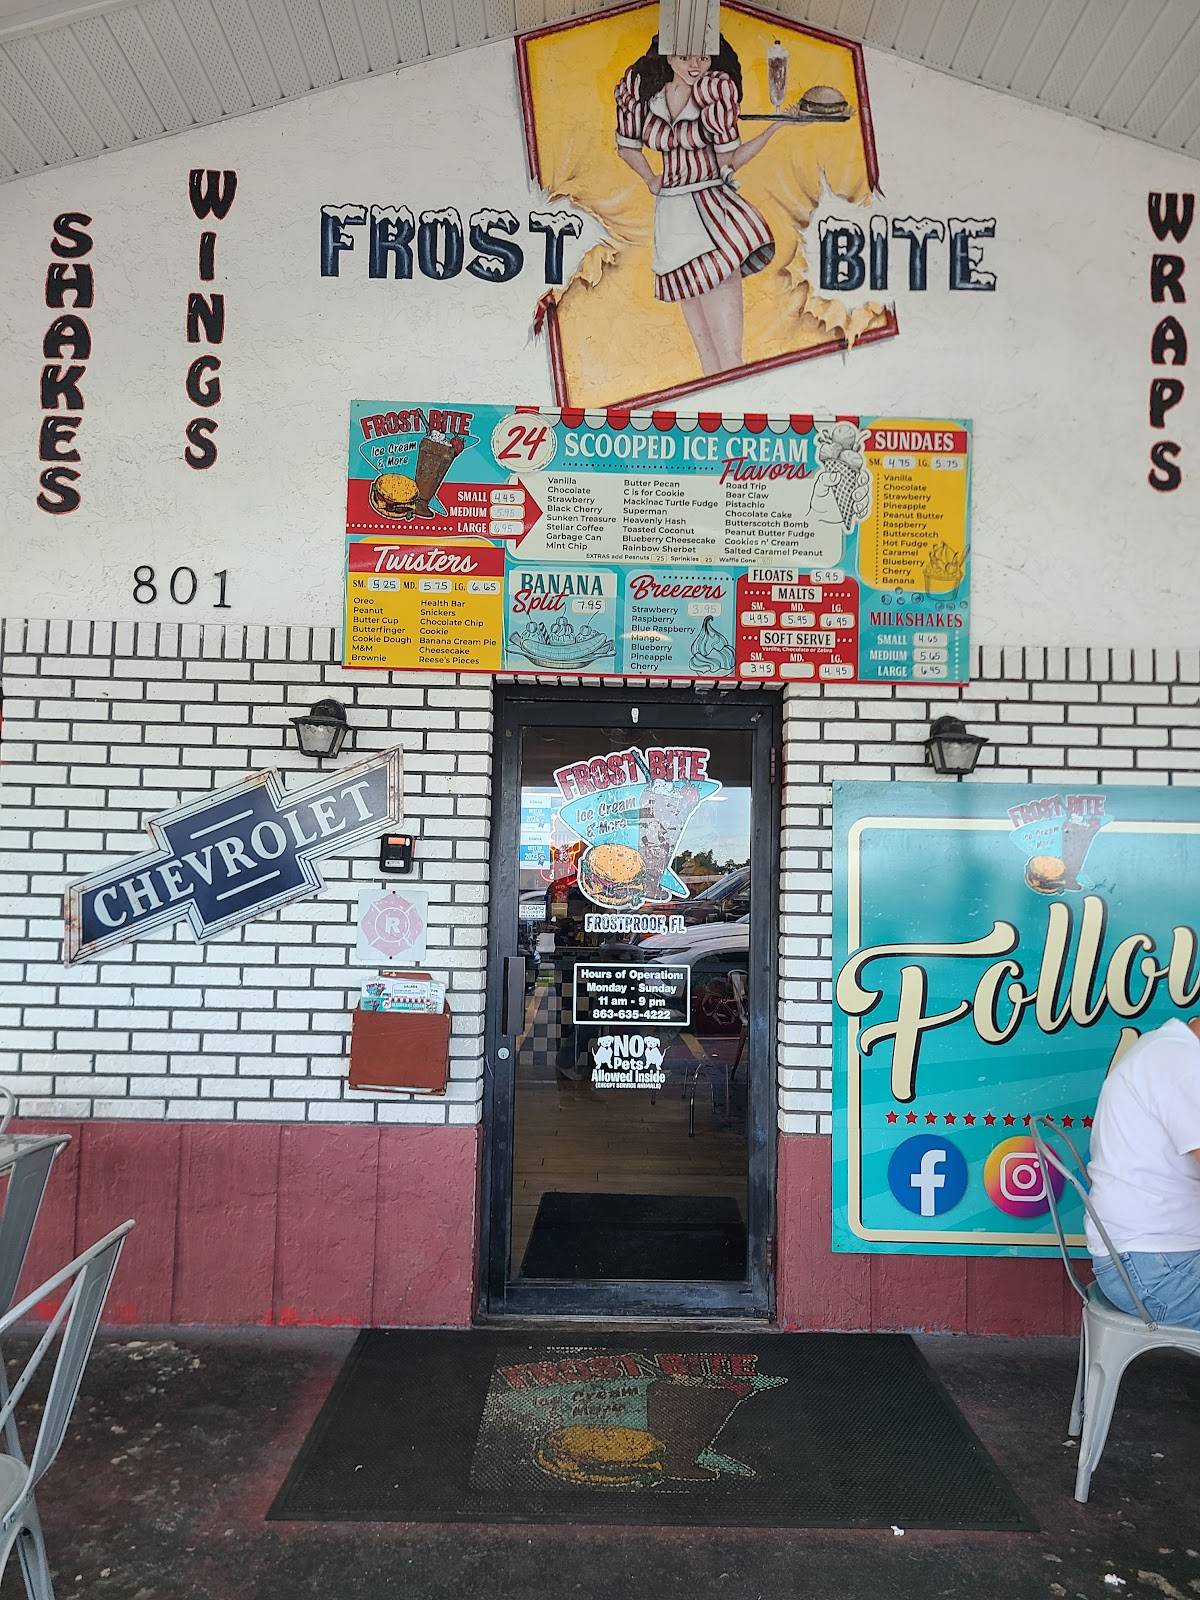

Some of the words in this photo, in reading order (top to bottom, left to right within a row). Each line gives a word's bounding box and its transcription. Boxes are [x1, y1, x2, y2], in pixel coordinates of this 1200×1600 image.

[319, 204, 583, 284] FROST
[817, 214, 997, 292] BITE
[185, 168, 237, 470] WINGS
[1148, 193, 1195, 492] WRAPS
[36, 211, 94, 514] SHAKES
[360, 410, 421, 439] FROST
[430, 410, 472, 435] BITE
[498, 425, 546, 460] 24
[875, 432, 955, 450] SUNDAES
[372, 446, 385, 456] Ice
[388, 442, 416, 454] Cream
[565, 432, 676, 460] SCOOPED
[683, 438, 718, 460] ICE
[726, 439, 808, 463] CREAM
[387, 456, 408, 466] More
[719, 457, 812, 484] Flavors
[548, 477, 577, 485] Vanilla
[548, 486, 591, 494] Chocolate
[458, 491, 487, 502] SMALL
[547, 496, 595, 505] Strawberry
[692, 500, 718, 508] Fudge
[450, 507, 487, 517] MEDIUM
[574, 506, 602, 514] Cherry
[623, 508, 667, 516] Superman
[547, 514, 578, 522] Sunken
[623, 517, 662, 525] Heavenly
[458, 522, 486, 533] LARGE
[725, 520, 780, 528] Butterscotch
[546, 533, 582, 541] Garbage
[623, 536, 663, 544] Blueberry
[788, 531, 815, 539] Fudge
[568, 543, 587, 551] Chip
[373, 546, 478, 573] Twisters
[753, 569, 793, 582] FLOATS
[132, 565, 232, 608] 801
[352, 579, 366, 589] SM.
[403, 581, 416, 590] MD.
[454, 582, 466, 591] LG.
[521, 574, 603, 596] BANANA
[630, 575, 726, 600] Breezers
[779, 588, 815, 600] MALTS
[512, 589, 569, 614] Split
[752, 601, 765, 611] SM.
[791, 603, 805, 611] MD.
[832, 604, 843, 612] LG.
[632, 605, 678, 615] Strawberry
[353, 616, 378, 624] Butter
[381, 617, 398, 625] Cup
[420, 618, 462, 626] Chocolate
[464, 619, 484, 628] Chip
[632, 614, 674, 624] Raspberry
[869, 612, 963, 627] MILKSHAKES
[352, 626, 406, 635] Butterfinger
[420, 627, 448, 635] Cookie
[383, 636, 412, 645] Dough
[484, 638, 496, 646] Pie
[764, 632, 795, 645] SOFT
[798, 634, 831, 646] SERVE
[877, 634, 907, 645] SMALL
[419, 647, 470, 655] Cheesecake
[631, 643, 672, 652] Blueberry
[352, 654, 386, 662] Brownie
[631, 652, 672, 662] Pineapple
[751, 652, 764, 662] SM.
[790, 653, 804, 662] MD.
[831, 654, 842, 663] LG.
[870, 650, 907, 661] MEDIUM
[877, 666, 907, 677] LARGE
[556, 751, 640, 800] FROST
[648, 750, 707, 780] BITE
[576, 807, 593, 821] Ice
[598, 797, 636, 815] Cream
[598, 818, 627, 835] More
[94, 781, 374, 927] CHEVROLET
[385, 916, 400, 934] R
[585, 916, 667, 934] FROSTPROOF,
[671, 916, 686, 932] FL
[581, 970, 611, 979] Hours
[615, 970, 626, 979] of
[630, 970, 683, 981] Operation:
[587, 983, 627, 993] Monday
[638, 984, 676, 995] Sunday
[598, 997, 609, 1005] 11
[639, 998, 646, 1006] 9
[649, 999, 665, 1009] pm
[593, 1010, 670, 1019] 863-635-4222
[614, 1035, 644, 1057] NO
[614, 1057, 643, 1070] Pets
[592, 1069, 632, 1082] Allowed
[635, 1070, 665, 1083] Inside
